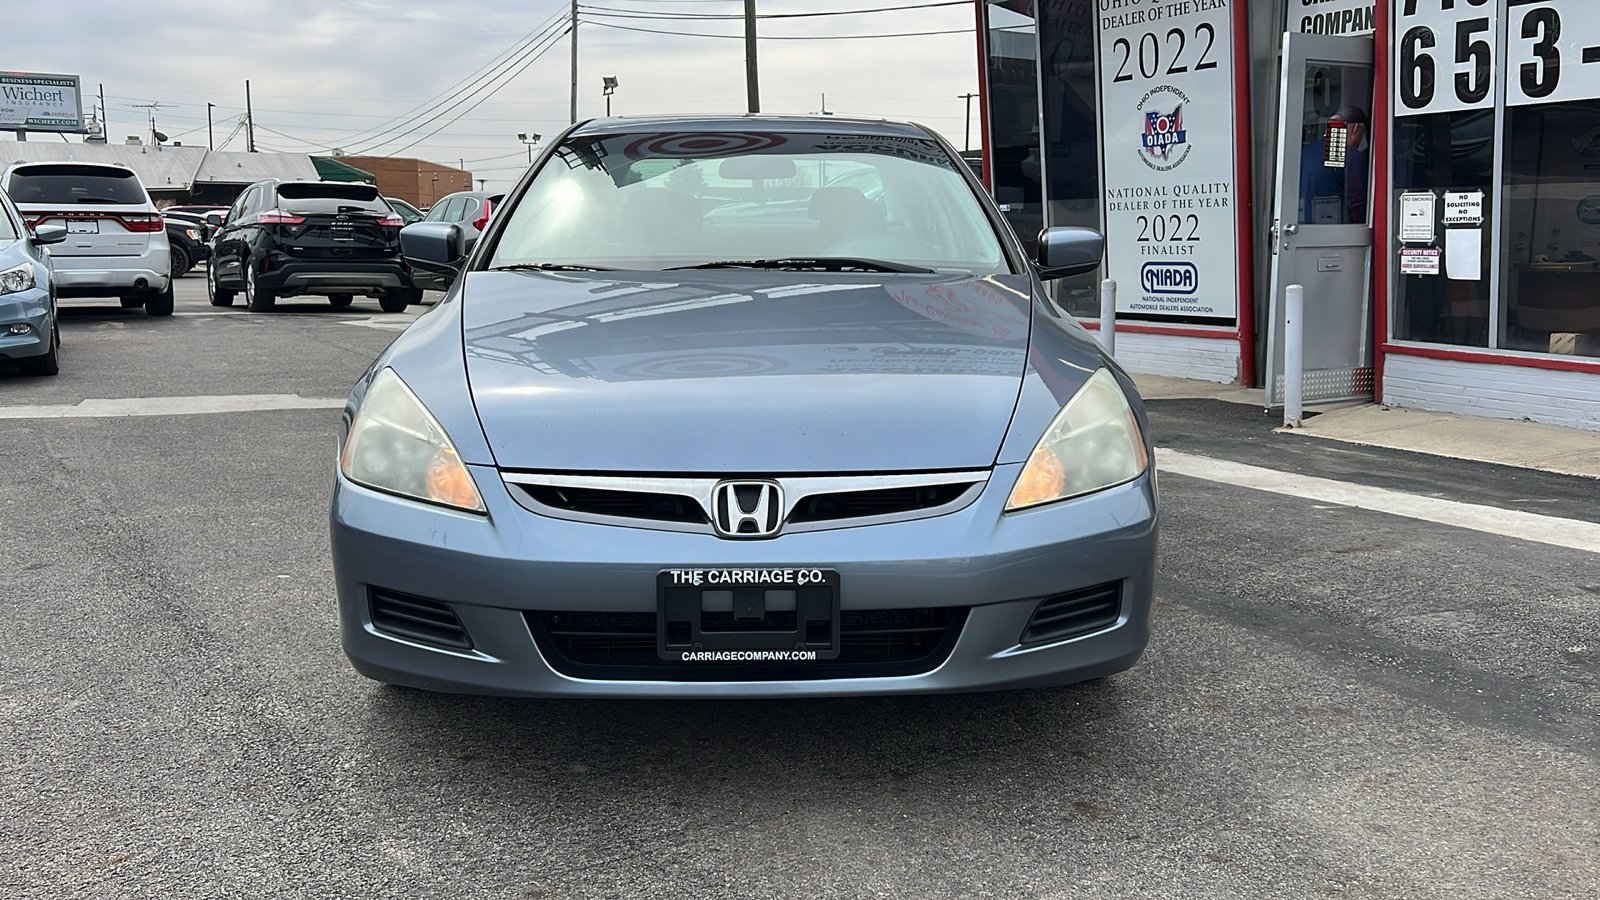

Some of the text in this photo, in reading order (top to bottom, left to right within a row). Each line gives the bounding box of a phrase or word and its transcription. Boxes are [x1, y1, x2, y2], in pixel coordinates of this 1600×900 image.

[1102, 10, 1146, 30] DEALER
[1147, 6, 1163, 21] OF
[1165, 2, 1190, 18] THE
[1192, 0, 1227, 13] YEAR
[1112, 22, 1218, 83] 2022
[2, 86, 64, 102] Wichert
[1137, 85, 1190, 111] OHIO INDEPENDENT
[1147, 132, 1178, 146] OIADA
[1137, 149, 1156, 170] AUTOMOBILE
[1172, 144, 1192, 168] ASSOCIATION
[1108, 183, 1230, 198] NATIONAL QUALITY
[1109, 197, 1229, 211] DEALER OF THE YEAR
[1136, 214, 1200, 242] 2022
[1141, 245, 1195, 255] FINALIST
[1146, 269, 1192, 287] NIADA
[670, 570, 826, 584] THE CARRIAGE CO.
[682, 651, 816, 661] CARRIAGECOMPANY.COM
